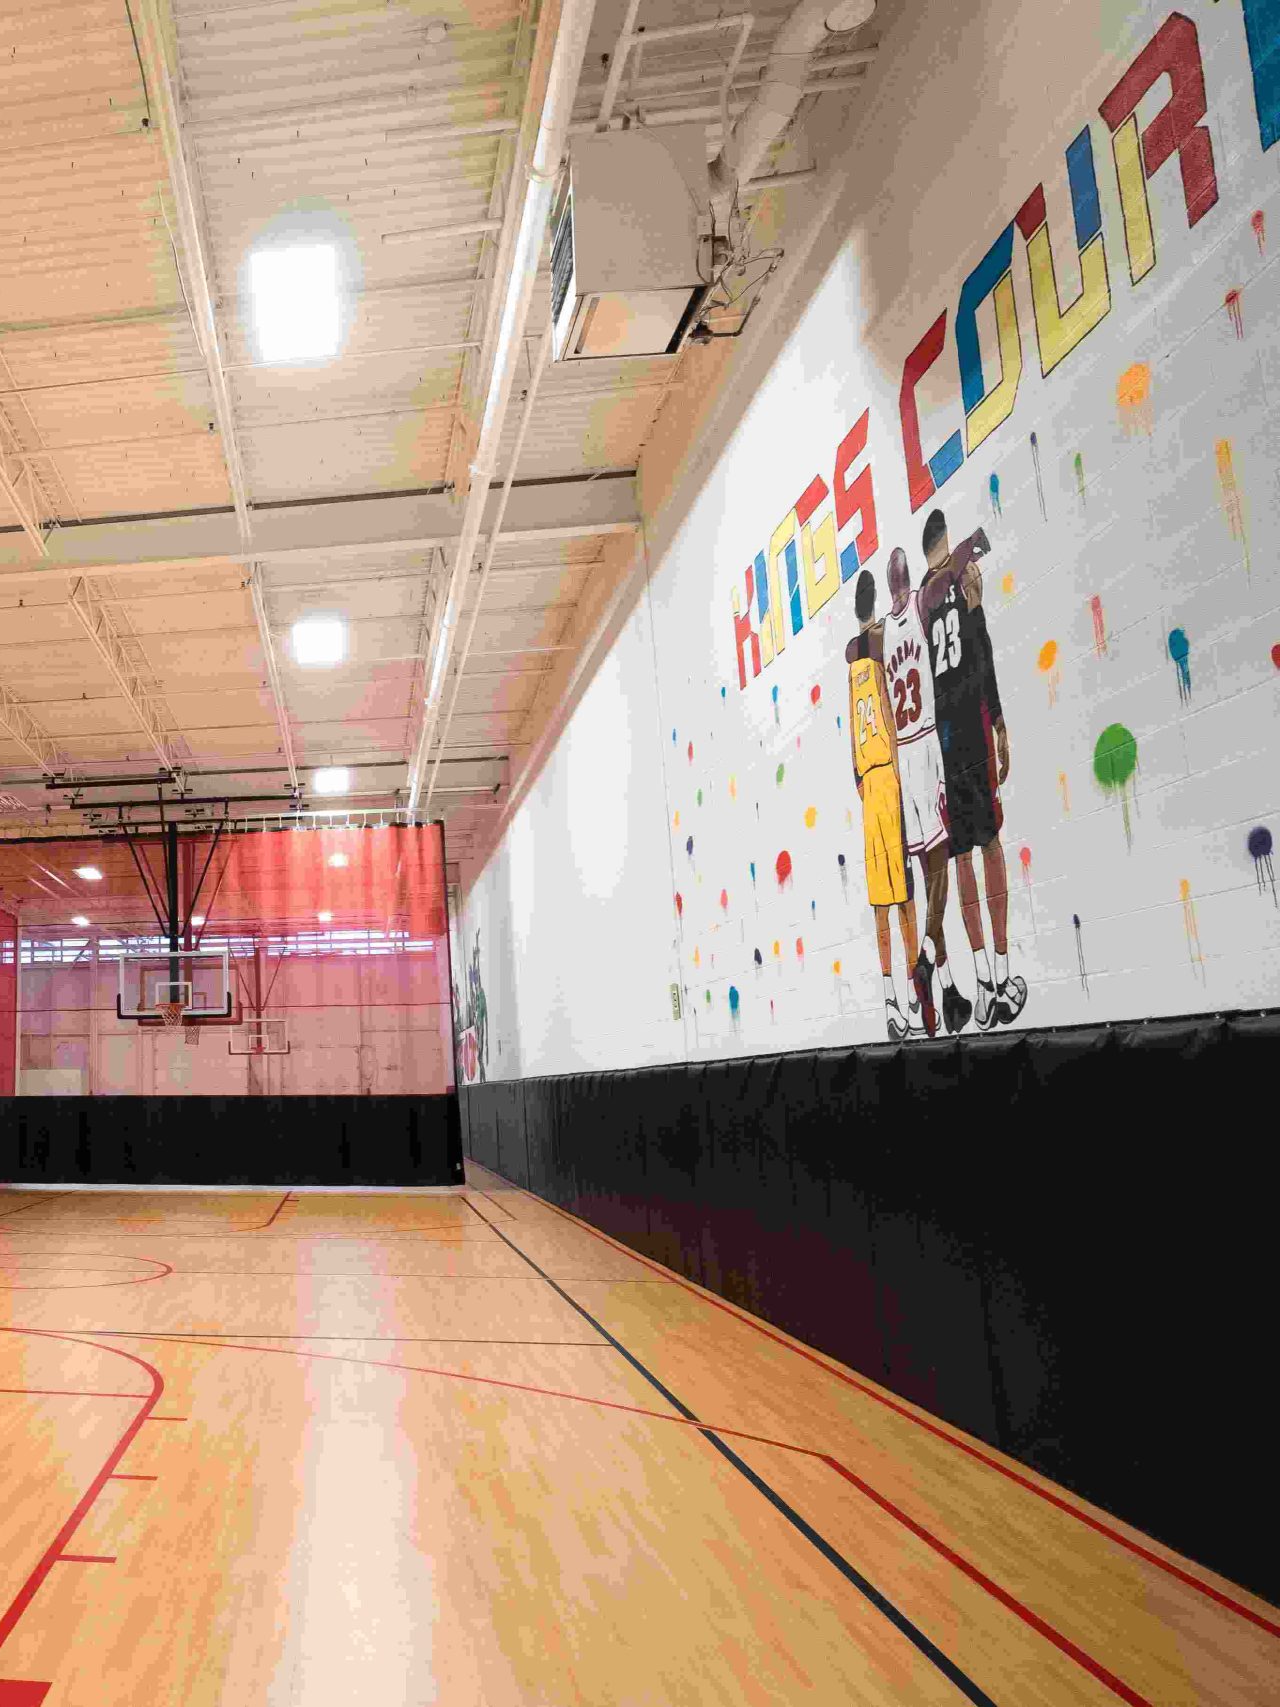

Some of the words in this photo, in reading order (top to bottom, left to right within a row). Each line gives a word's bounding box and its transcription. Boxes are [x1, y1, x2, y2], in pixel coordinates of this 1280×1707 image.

[731, 407, 879, 690] KINGS
[932, 607, 962, 678] 23
[856, 693, 878, 746] 24
[893, 668, 923, 731] 23
